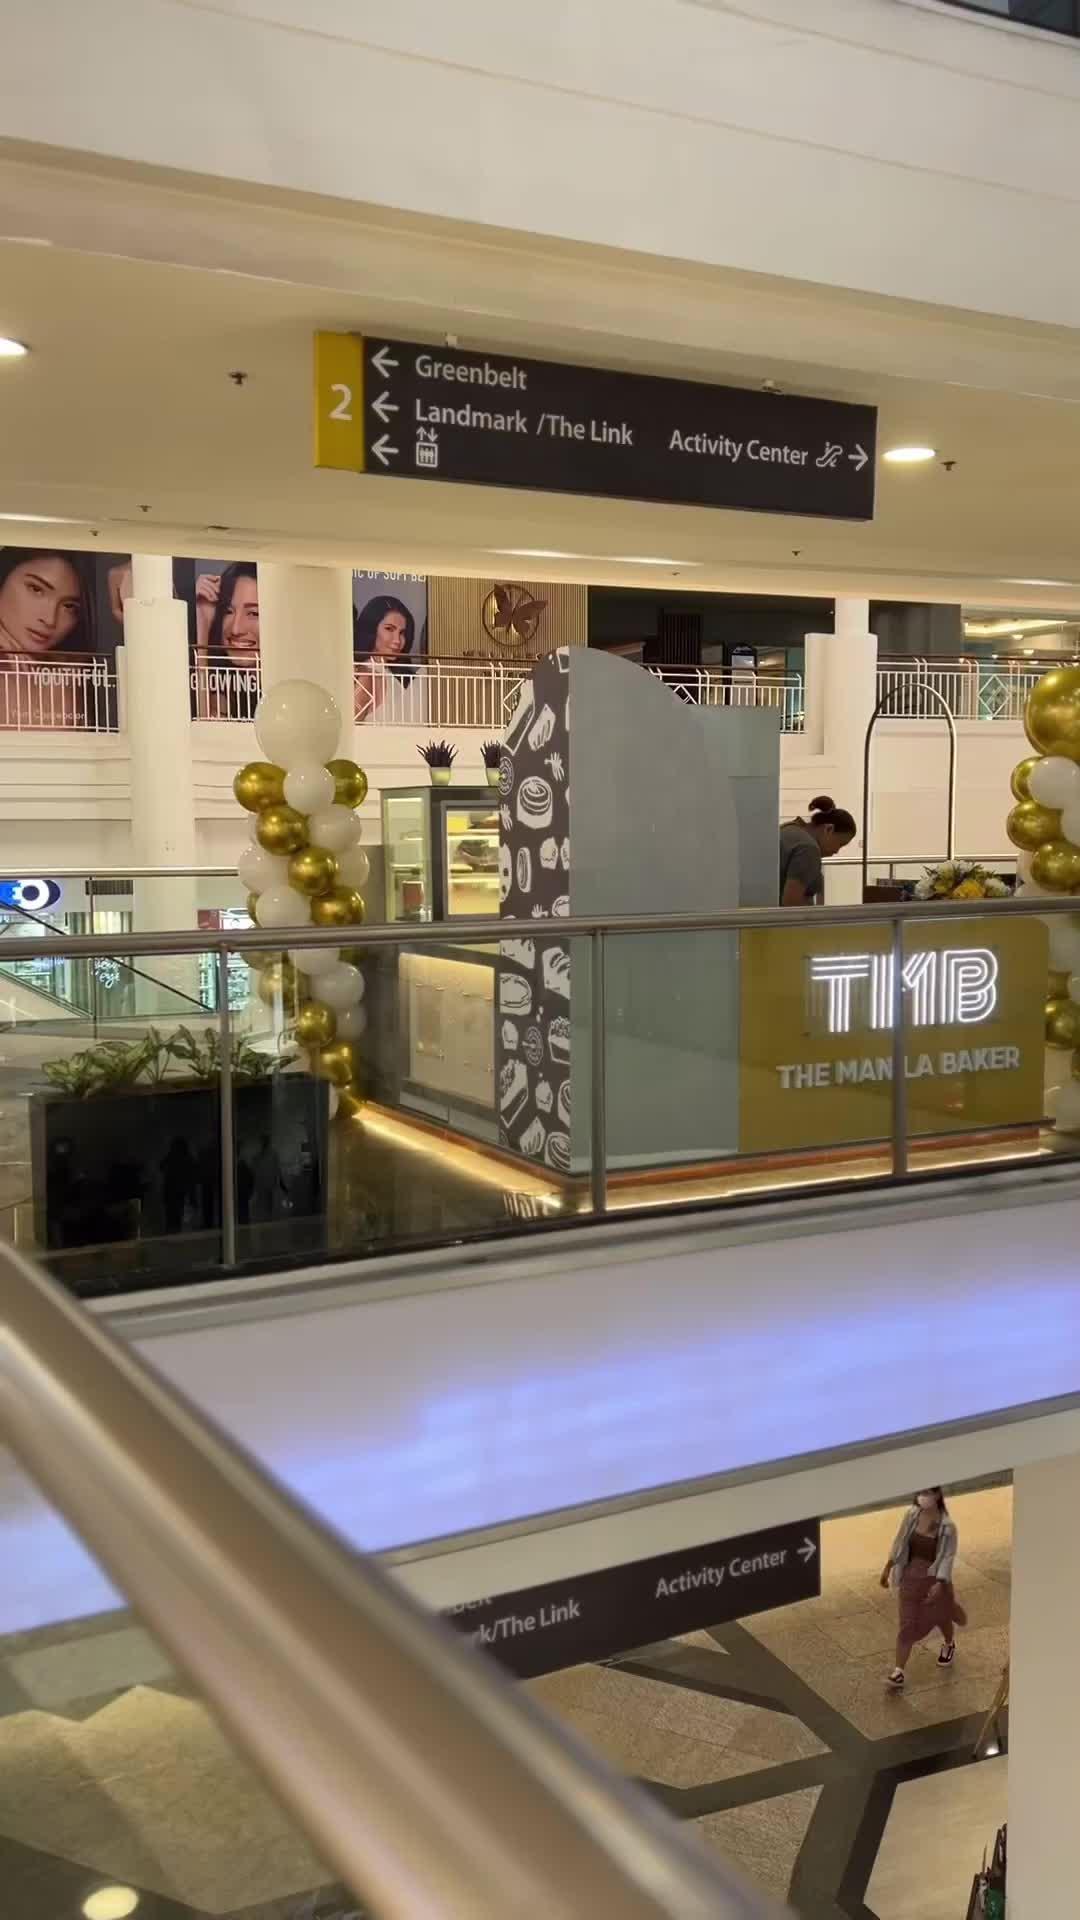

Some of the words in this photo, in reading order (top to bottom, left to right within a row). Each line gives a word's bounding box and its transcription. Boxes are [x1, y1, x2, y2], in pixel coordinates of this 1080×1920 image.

[415, 355, 527, 390] Greenbelt
[328, 383, 353, 421] 2
[416, 399, 528, 434] Landmark
[536, 413, 586, 440] /The
[591, 420, 633, 446] Link
[669, 429, 743, 463] Activity
[747, 440, 809, 465] Center
[811, 948, 999, 1033] TMB
[776, 1063, 831, 1089] THE
[836, 1053, 935, 1084] MANLA
[942, 1046, 1020, 1075] BAKER
[655, 1563, 725, 1598] Activity
[729, 1547, 788, 1577] Center
[540, 1597, 580, 1628] Link
